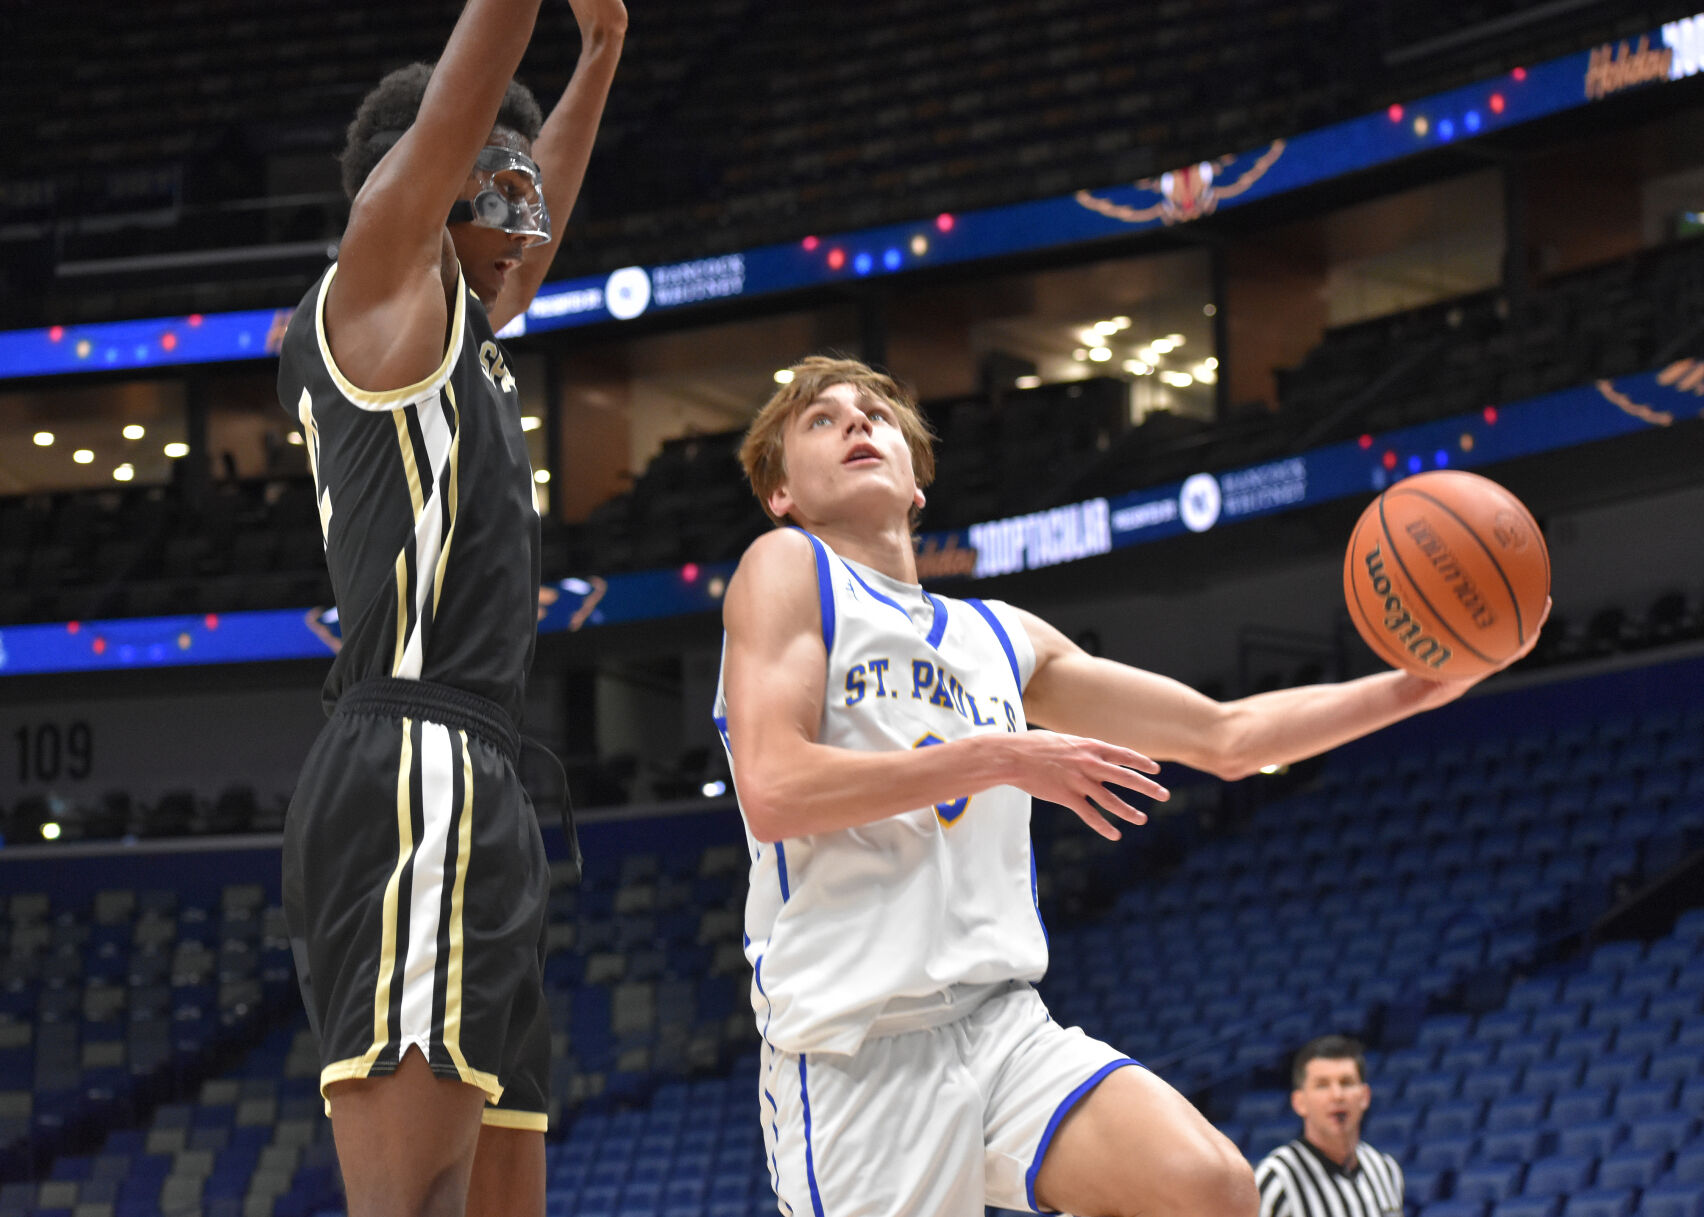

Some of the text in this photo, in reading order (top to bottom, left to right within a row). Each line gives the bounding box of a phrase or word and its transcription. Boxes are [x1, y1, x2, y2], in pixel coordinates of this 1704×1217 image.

[1364, 538, 1453, 669] Wilson
[844, 658, 1017, 733] ST. PAUL'S
[15, 721, 93, 784] 109
